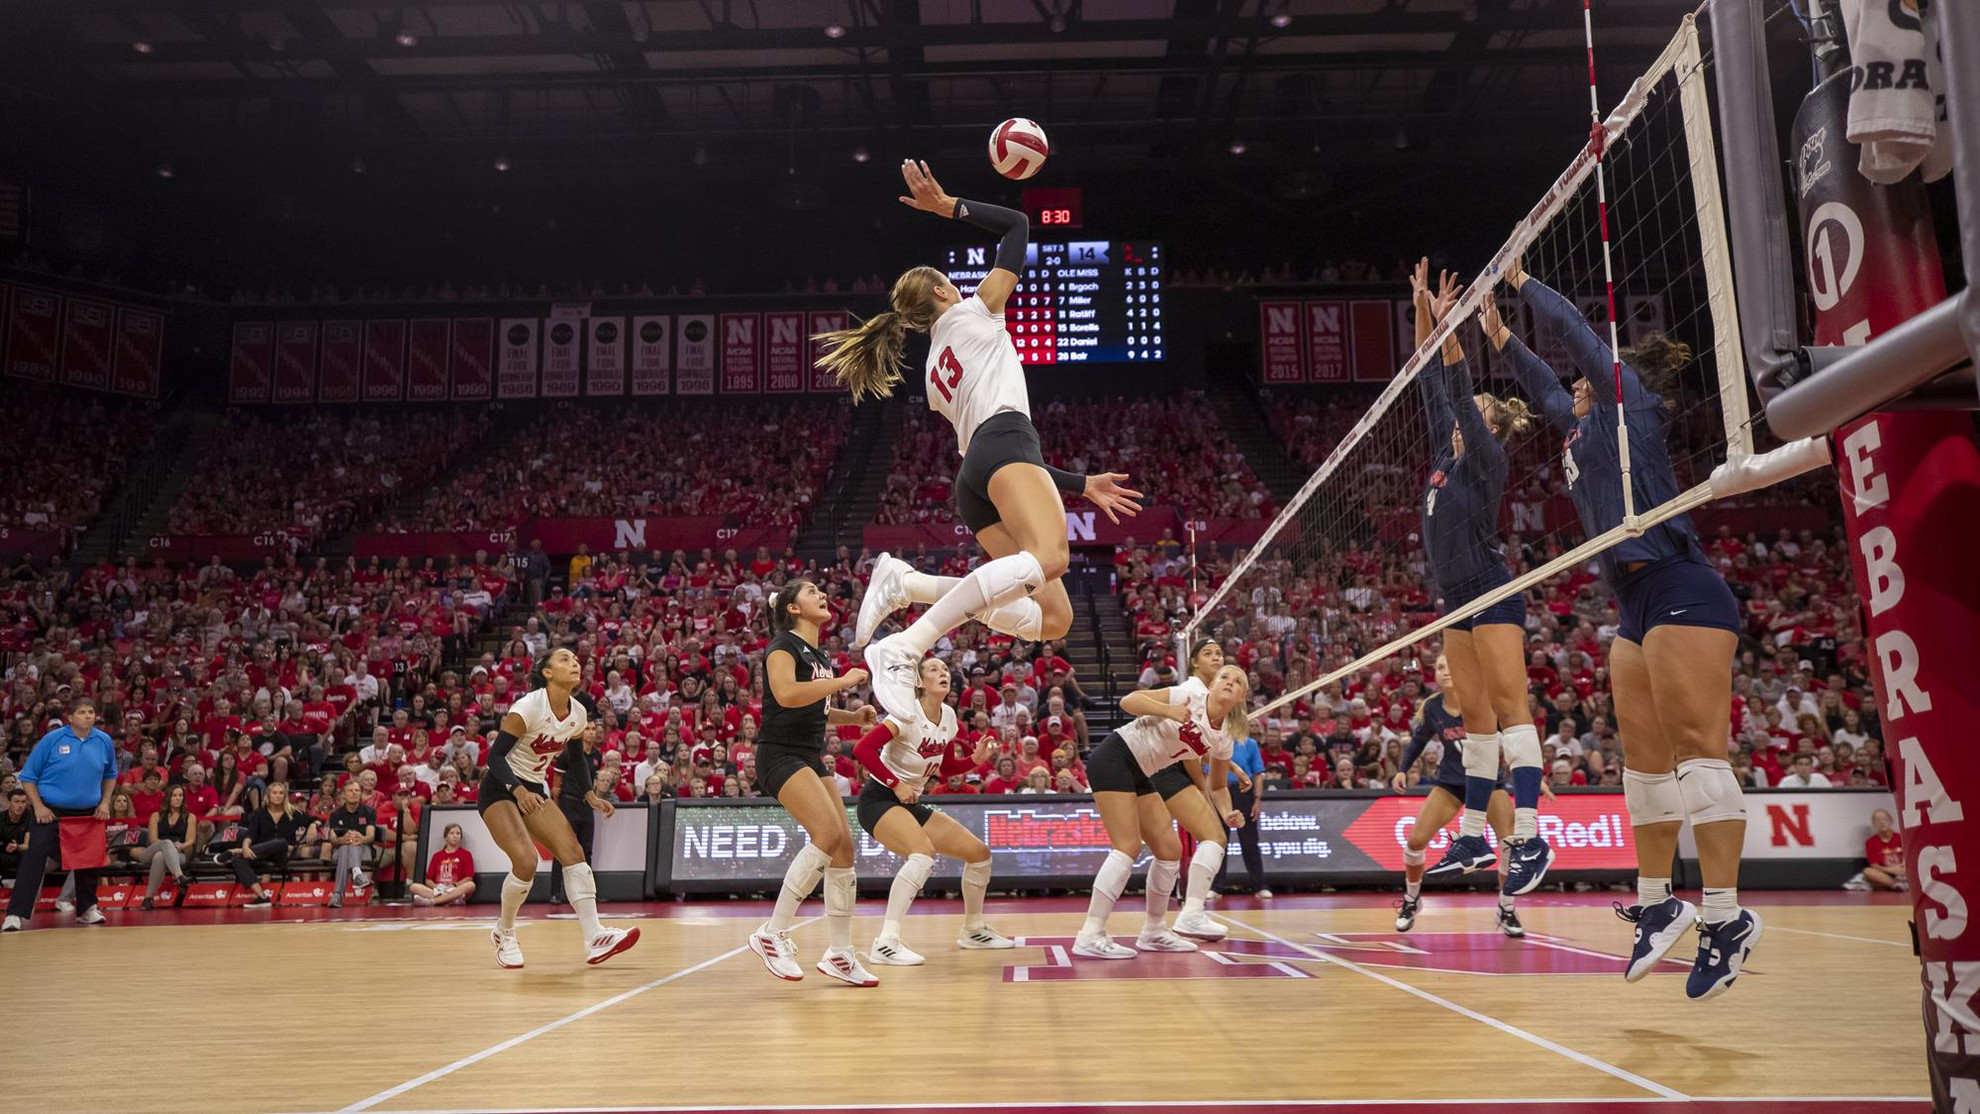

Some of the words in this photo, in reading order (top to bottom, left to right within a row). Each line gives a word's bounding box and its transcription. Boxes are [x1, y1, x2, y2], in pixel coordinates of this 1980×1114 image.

[1041, 210, 1070, 224] 8:30
[967, 248, 985, 265] N
[1078, 247, 1095, 260] 14
[1046, 257, 1061, 265] 2-0
[948, 271, 988, 280] NEBRASK
[1029, 270, 1036, 278] B
[1042, 270, 1049, 278] D
[1057, 269, 1075, 277] OLE
[1125, 268, 1132, 276] K
[1150, 267, 1159, 275] D
[1016, 284, 1023, 292] 0
[1030, 284, 1037, 292] 0
[1058, 283, 1065, 291] 4
[1069, 283, 1099, 292] Brgoch
[1126, 282, 1133, 290] 2
[1152, 281, 1159, 289] 0
[1030, 297, 1037, 305] 0
[1044, 297, 1051, 305] 7
[1058, 297, 1065, 305] 7
[1069, 297, 1092, 305] Miller
[1126, 295, 1133, 303] 6
[1139, 295, 1146, 303] 0
[1031, 311, 1037, 319] 2
[1126, 309, 1134, 317] 4
[1139, 308, 1147, 317] 2
[1153, 308, 1160, 316] 0
[1268, 307, 1296, 334] N
[1312, 306, 1341, 333] N
[727, 318, 754, 344] N
[771, 317, 798, 344] N
[1017, 325, 1024, 333] 0
[1044, 324, 1051, 332] 9
[1016, 339, 1025, 347] 12
[1031, 339, 1038, 347] 0
[1044, 338, 1052, 346] 4
[1057, 338, 1069, 347] 22
[1127, 336, 1134, 345] 0
[1140, 336, 1148, 345] 0
[1154, 336, 1161, 344] 0
[1127, 351, 1135, 359] 9
[1141, 350, 1148, 358] 4
[1154, 350, 1161, 358] 2
[931, 346, 964, 404] 13
[1270, 364, 1299, 379] 2015
[1314, 363, 1343, 378] 2017
[726, 375, 754, 389] 1995
[770, 374, 799, 388] 2000
[456, 383, 487, 395] 1999
[1510, 502, 1545, 531] N
[1067, 511, 1097, 541] N
[489, 532, 511, 543] C17
[614, 519, 647, 548] N
[150, 537, 171, 548] C16
[533, 755, 548, 772] 2
[1260, 811, 1320, 831] below.
[1766, 804, 1815, 847] N
[123, 830, 141, 845] N
[1538, 815, 1624, 848] Red!
[683, 825, 787, 859] NEED
[1273, 842, 1302, 859] you
